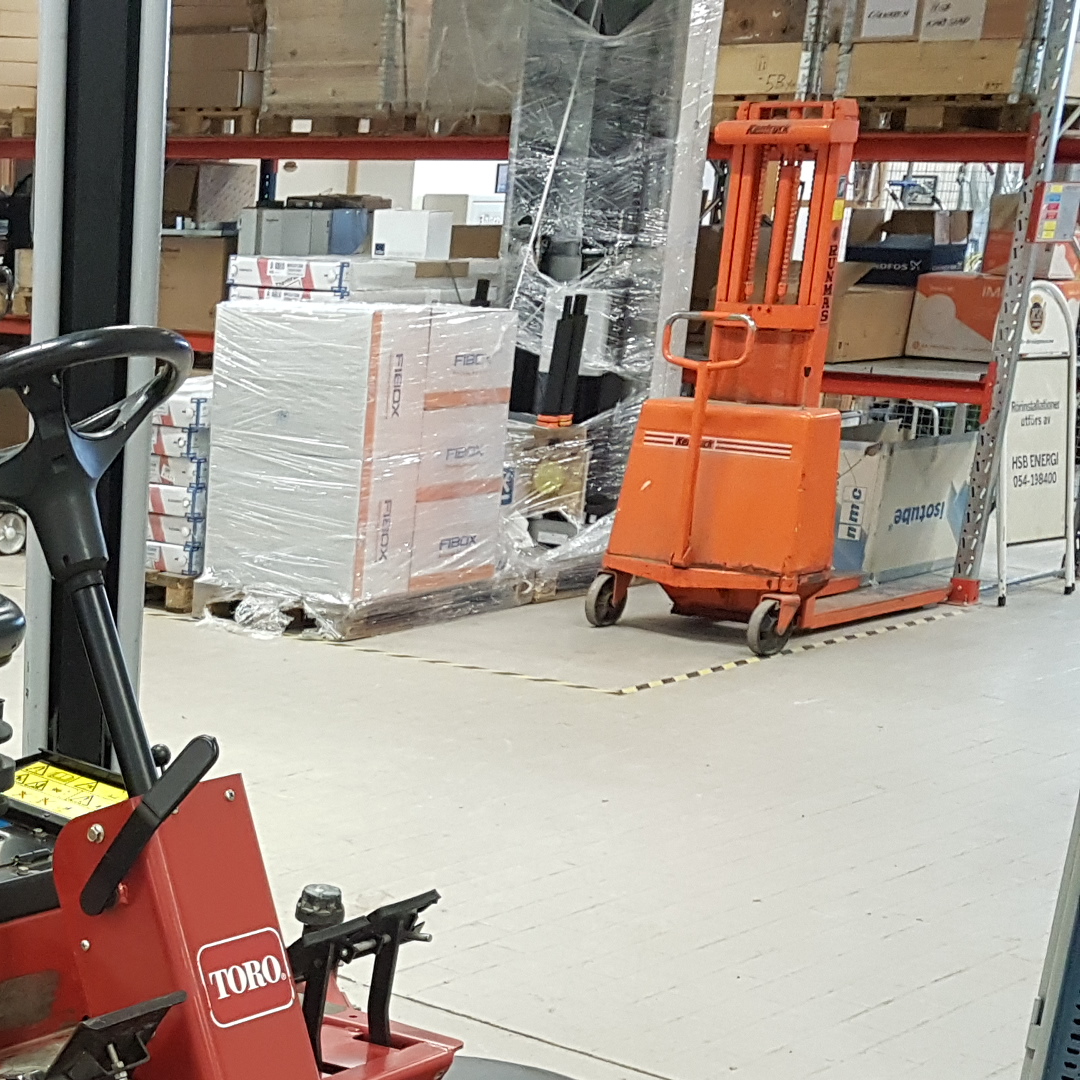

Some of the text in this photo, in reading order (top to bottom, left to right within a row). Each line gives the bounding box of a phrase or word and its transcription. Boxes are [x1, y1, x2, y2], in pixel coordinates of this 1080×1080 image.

[1043, 416, 1051, 425] av
[1011, 452, 1059, 470] HSB ENERGI
[439, 535, 477, 550] FIBOX
[208, 955, 281, 1000] TORO
